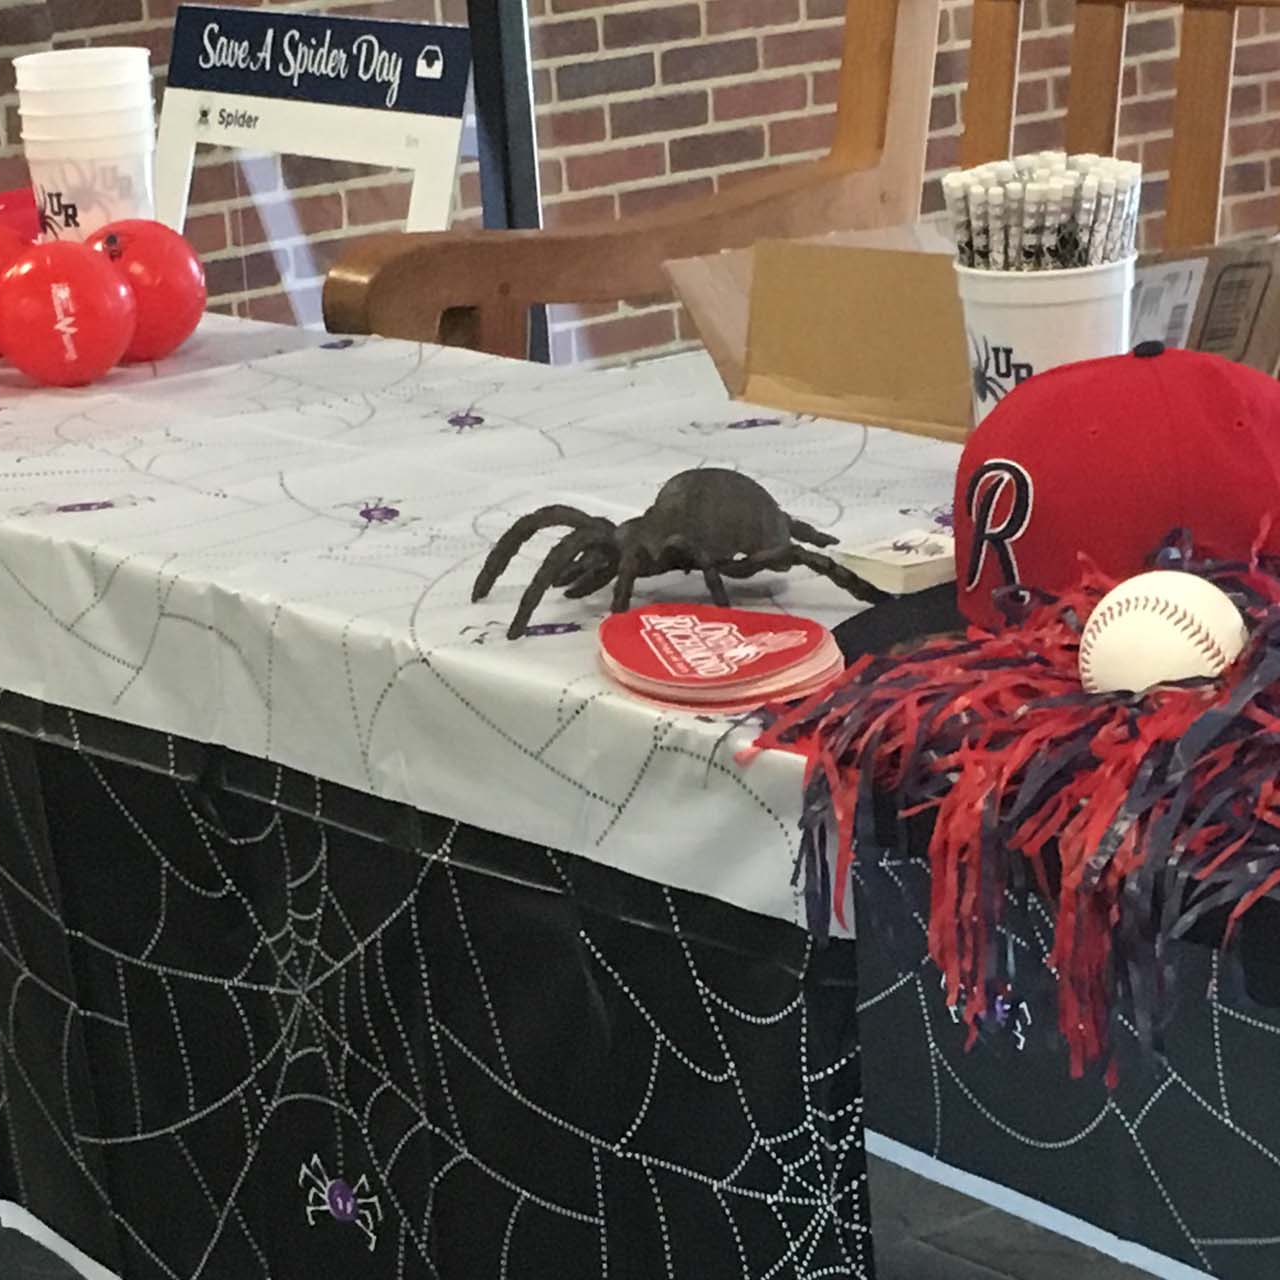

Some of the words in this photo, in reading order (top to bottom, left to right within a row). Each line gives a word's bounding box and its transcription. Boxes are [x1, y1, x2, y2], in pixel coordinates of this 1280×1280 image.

[198, 22, 251, 70] Save
[250, 28, 275, 71] A
[278, 28, 350, 87] Spider
[352, 33, 404, 108] Day
[217, 108, 260, 130] Spider
[46, 192, 81, 228] UR
[965, 458, 1035, 593] R
